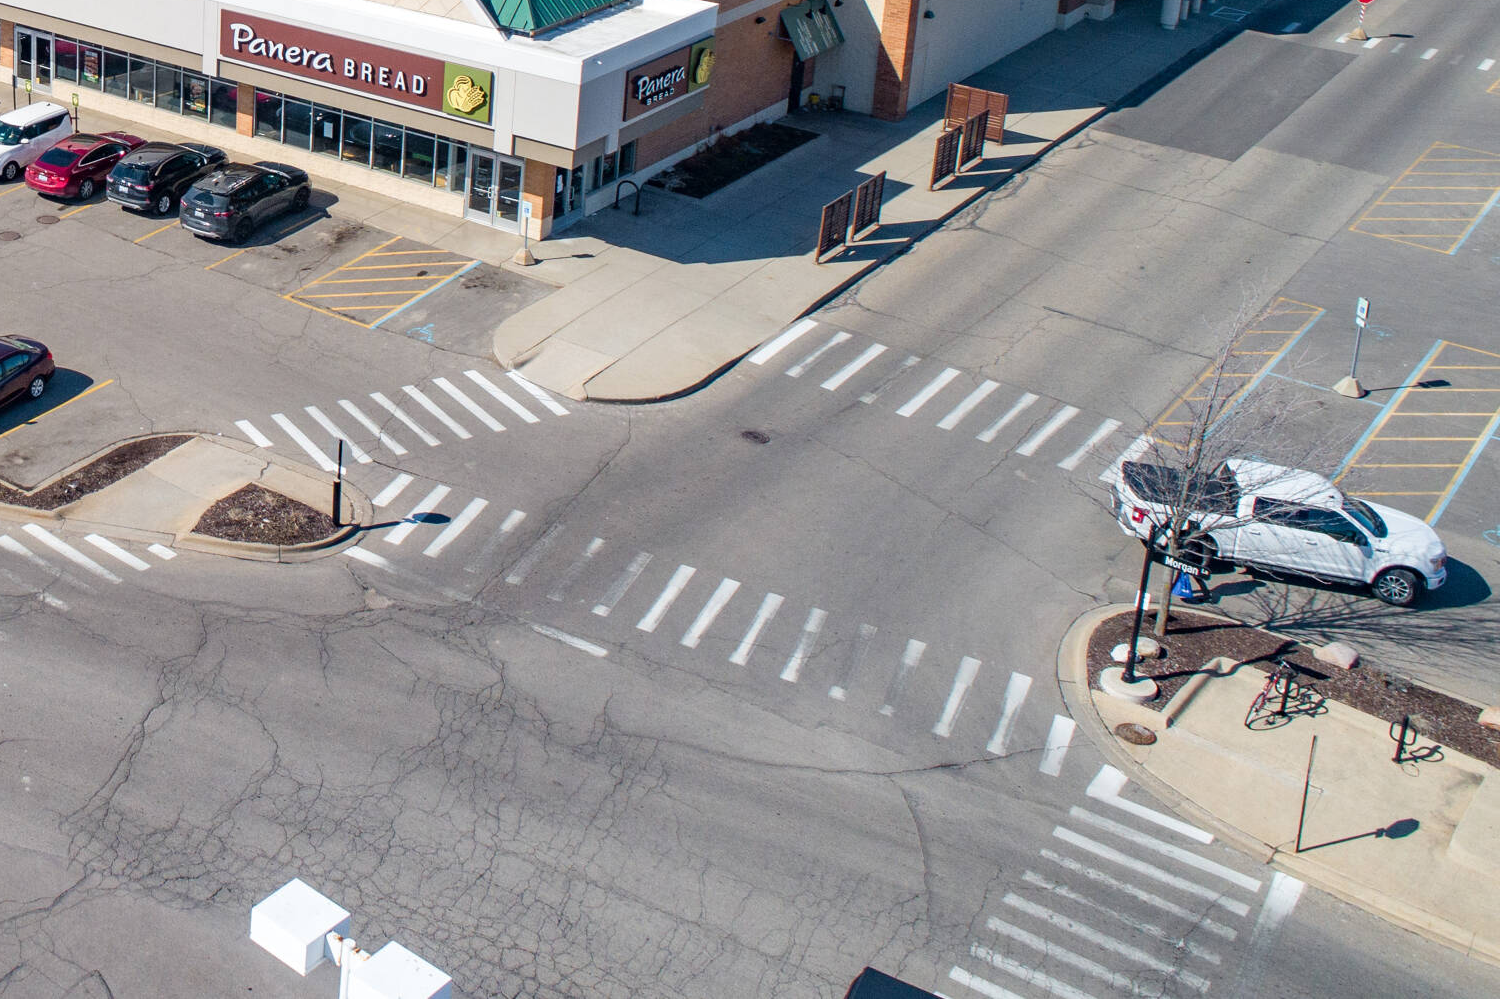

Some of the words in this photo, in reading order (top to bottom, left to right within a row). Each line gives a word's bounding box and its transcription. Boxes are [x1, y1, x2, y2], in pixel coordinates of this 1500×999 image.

[230, 23, 335, 74] Panera
[344, 57, 427, 96] BREAD
[636, 65, 685, 101] Panera
[646, 87, 675, 106] BREAD
[1165, 555, 1199, 576] Morgan
